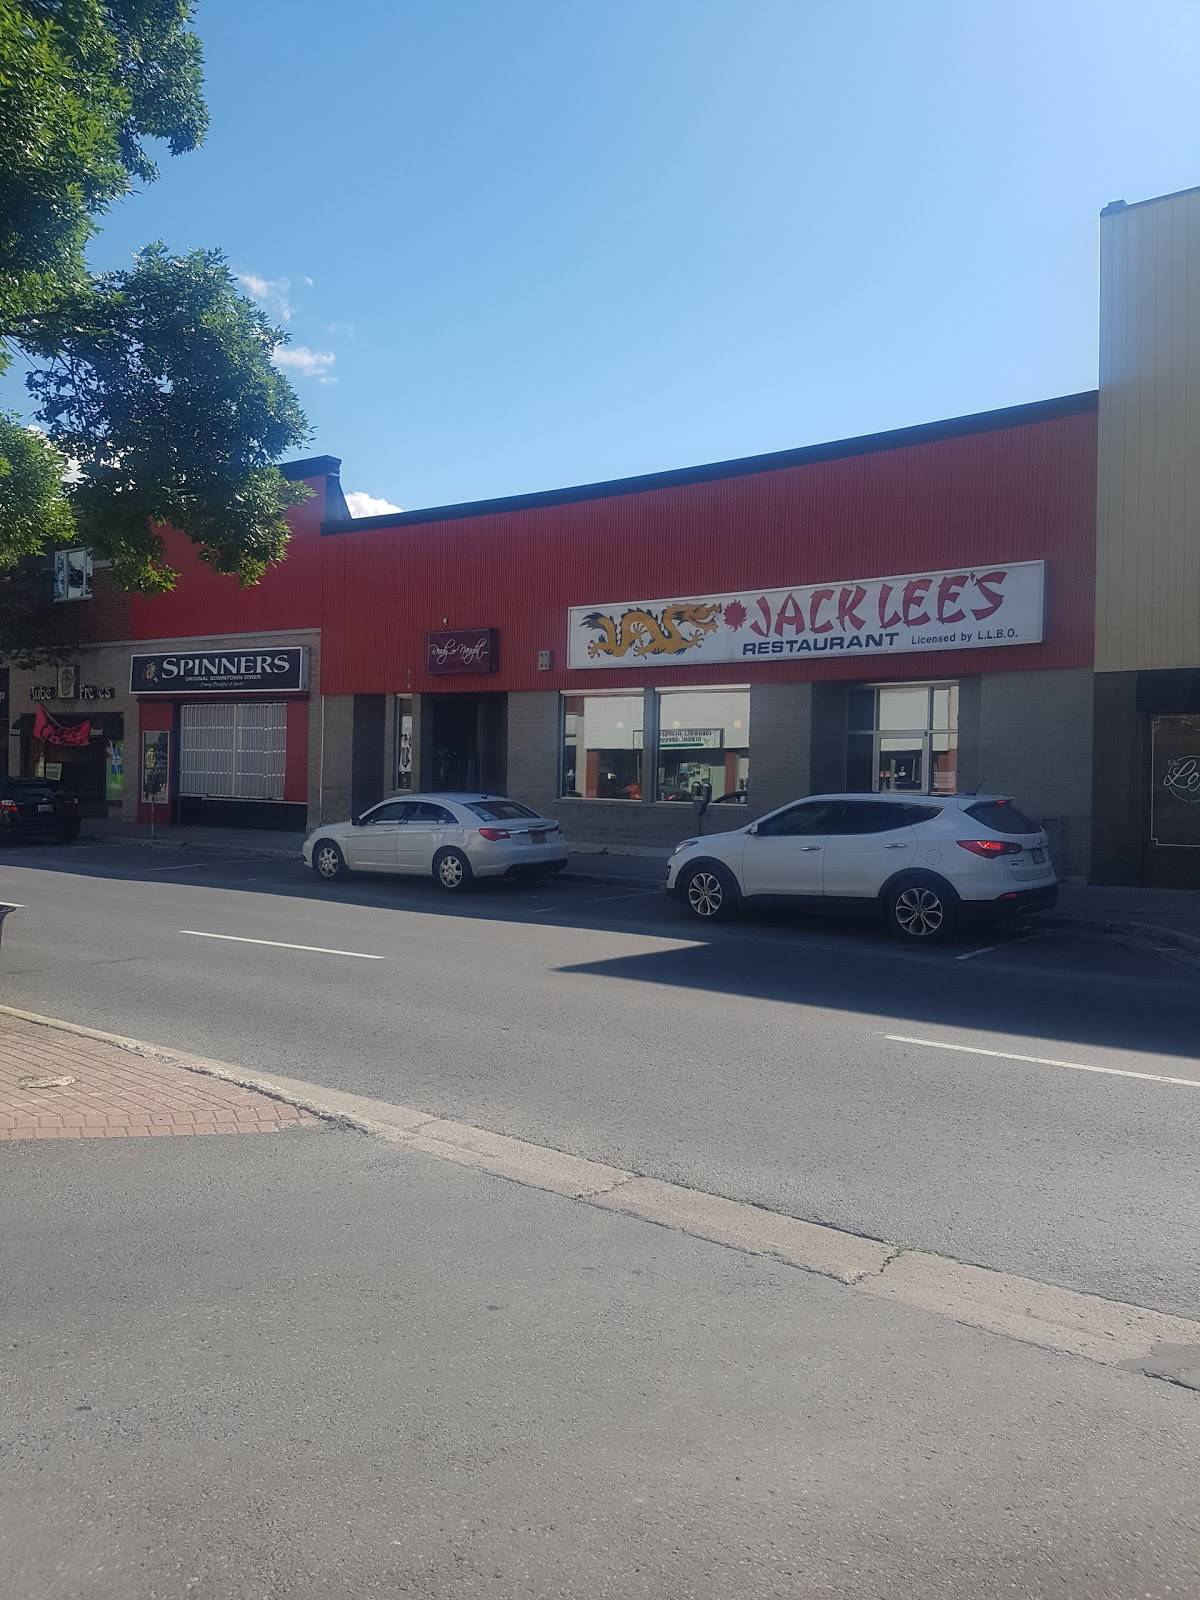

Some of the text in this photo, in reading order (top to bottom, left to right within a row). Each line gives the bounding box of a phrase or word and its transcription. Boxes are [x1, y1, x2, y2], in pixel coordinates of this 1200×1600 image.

[750, 571, 1008, 638] JACK LEE'S
[742, 632, 900, 656] RESTAURANT
[911, 628, 1019, 645] Licensed by L.L.B.O.
[161, 654, 291, 679] SPINNERS
[209, 674, 243, 682] DOWNTOWN
